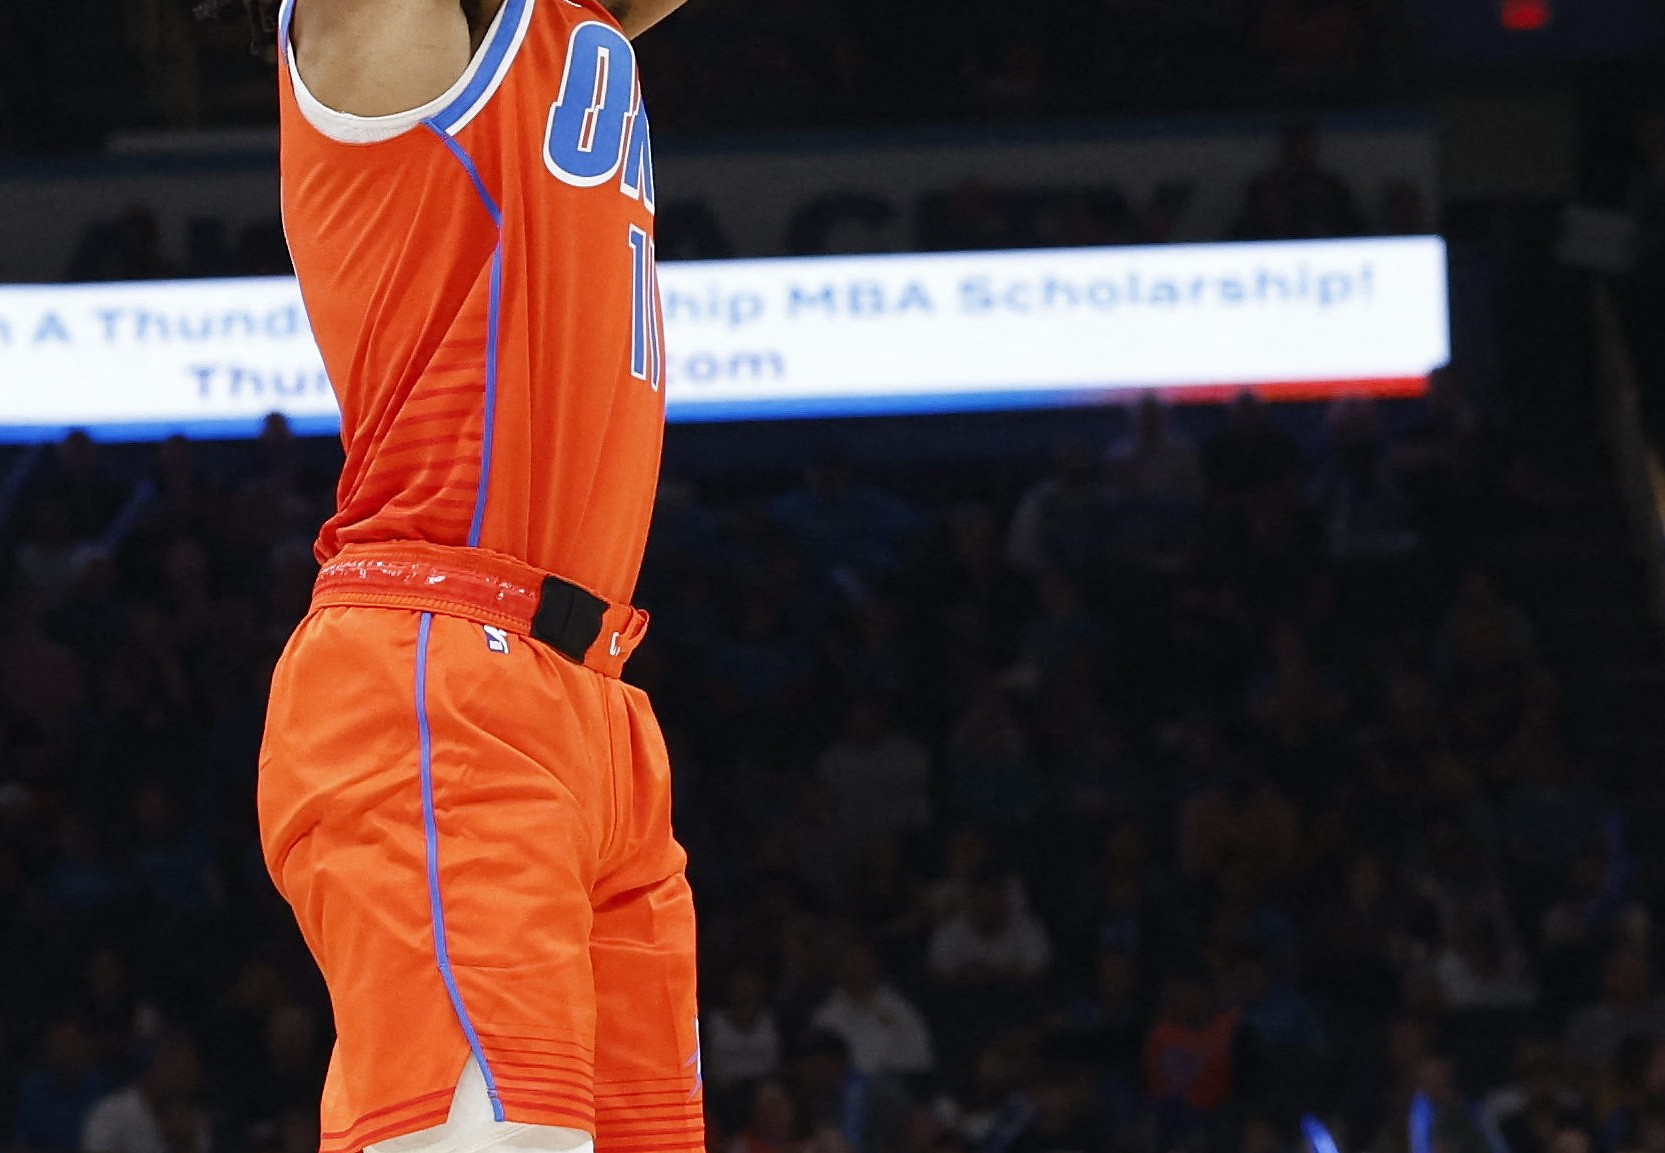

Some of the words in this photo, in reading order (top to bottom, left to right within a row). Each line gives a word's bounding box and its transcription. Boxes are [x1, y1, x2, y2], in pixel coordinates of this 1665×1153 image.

[33, 309, 71, 341] A
[94, 303, 306, 342] Thund
[786, 278, 934, 317] MBA
[957, 262, 1375, 314] Scholarship!
